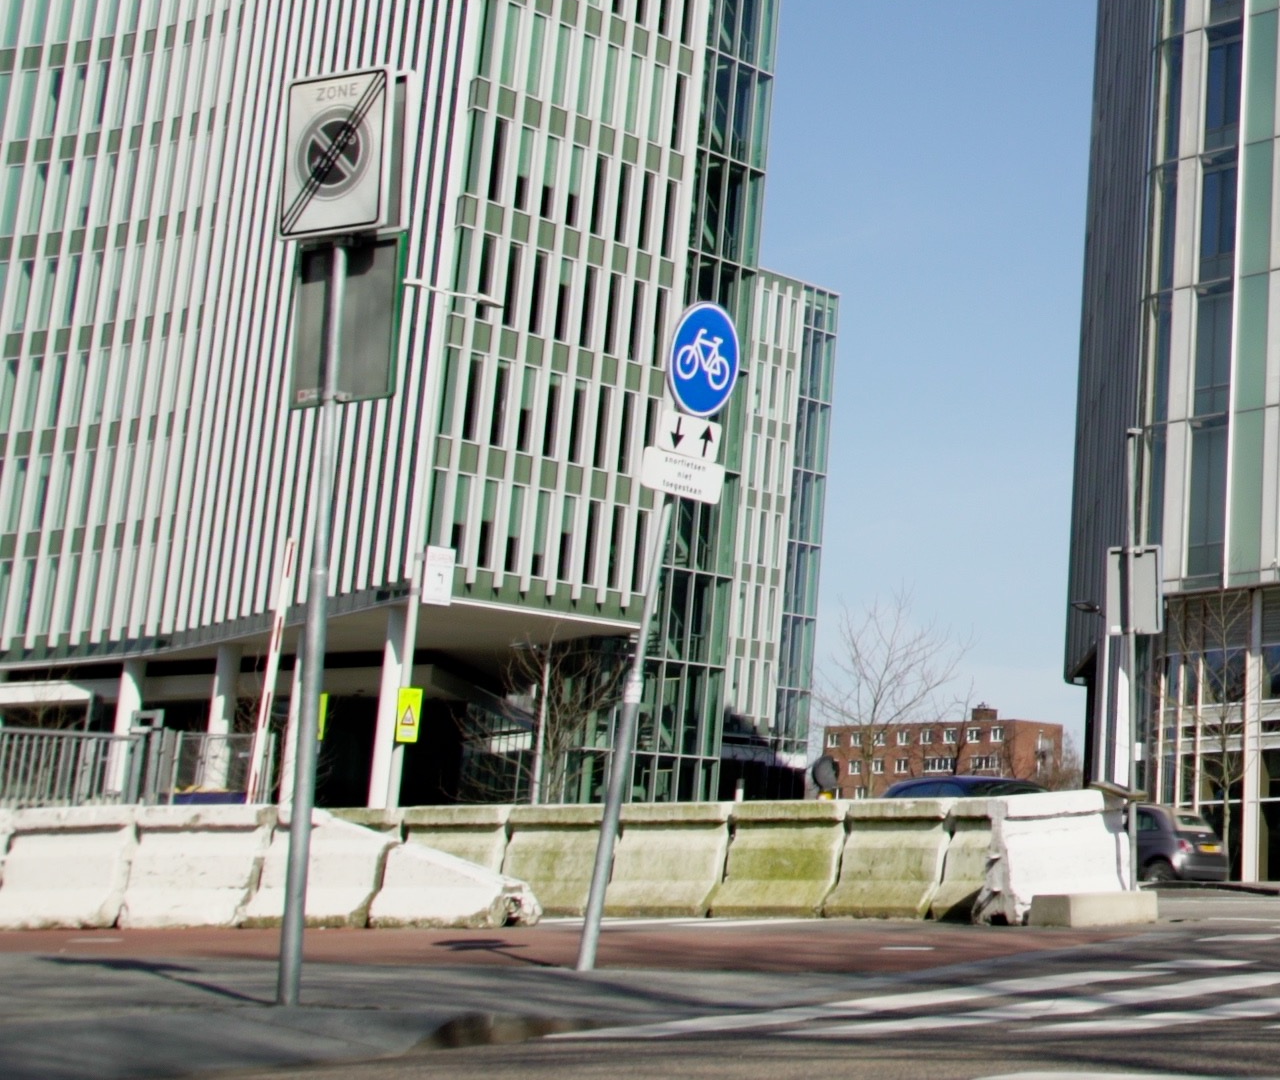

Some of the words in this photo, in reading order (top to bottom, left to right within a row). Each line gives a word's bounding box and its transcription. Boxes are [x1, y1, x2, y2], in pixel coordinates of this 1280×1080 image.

[315, 82, 359, 102] ZONE
[664, 456, 706, 471] snorfietsen
[677, 471, 692, 481] niet
[662, 479, 702, 495] toegestaan
